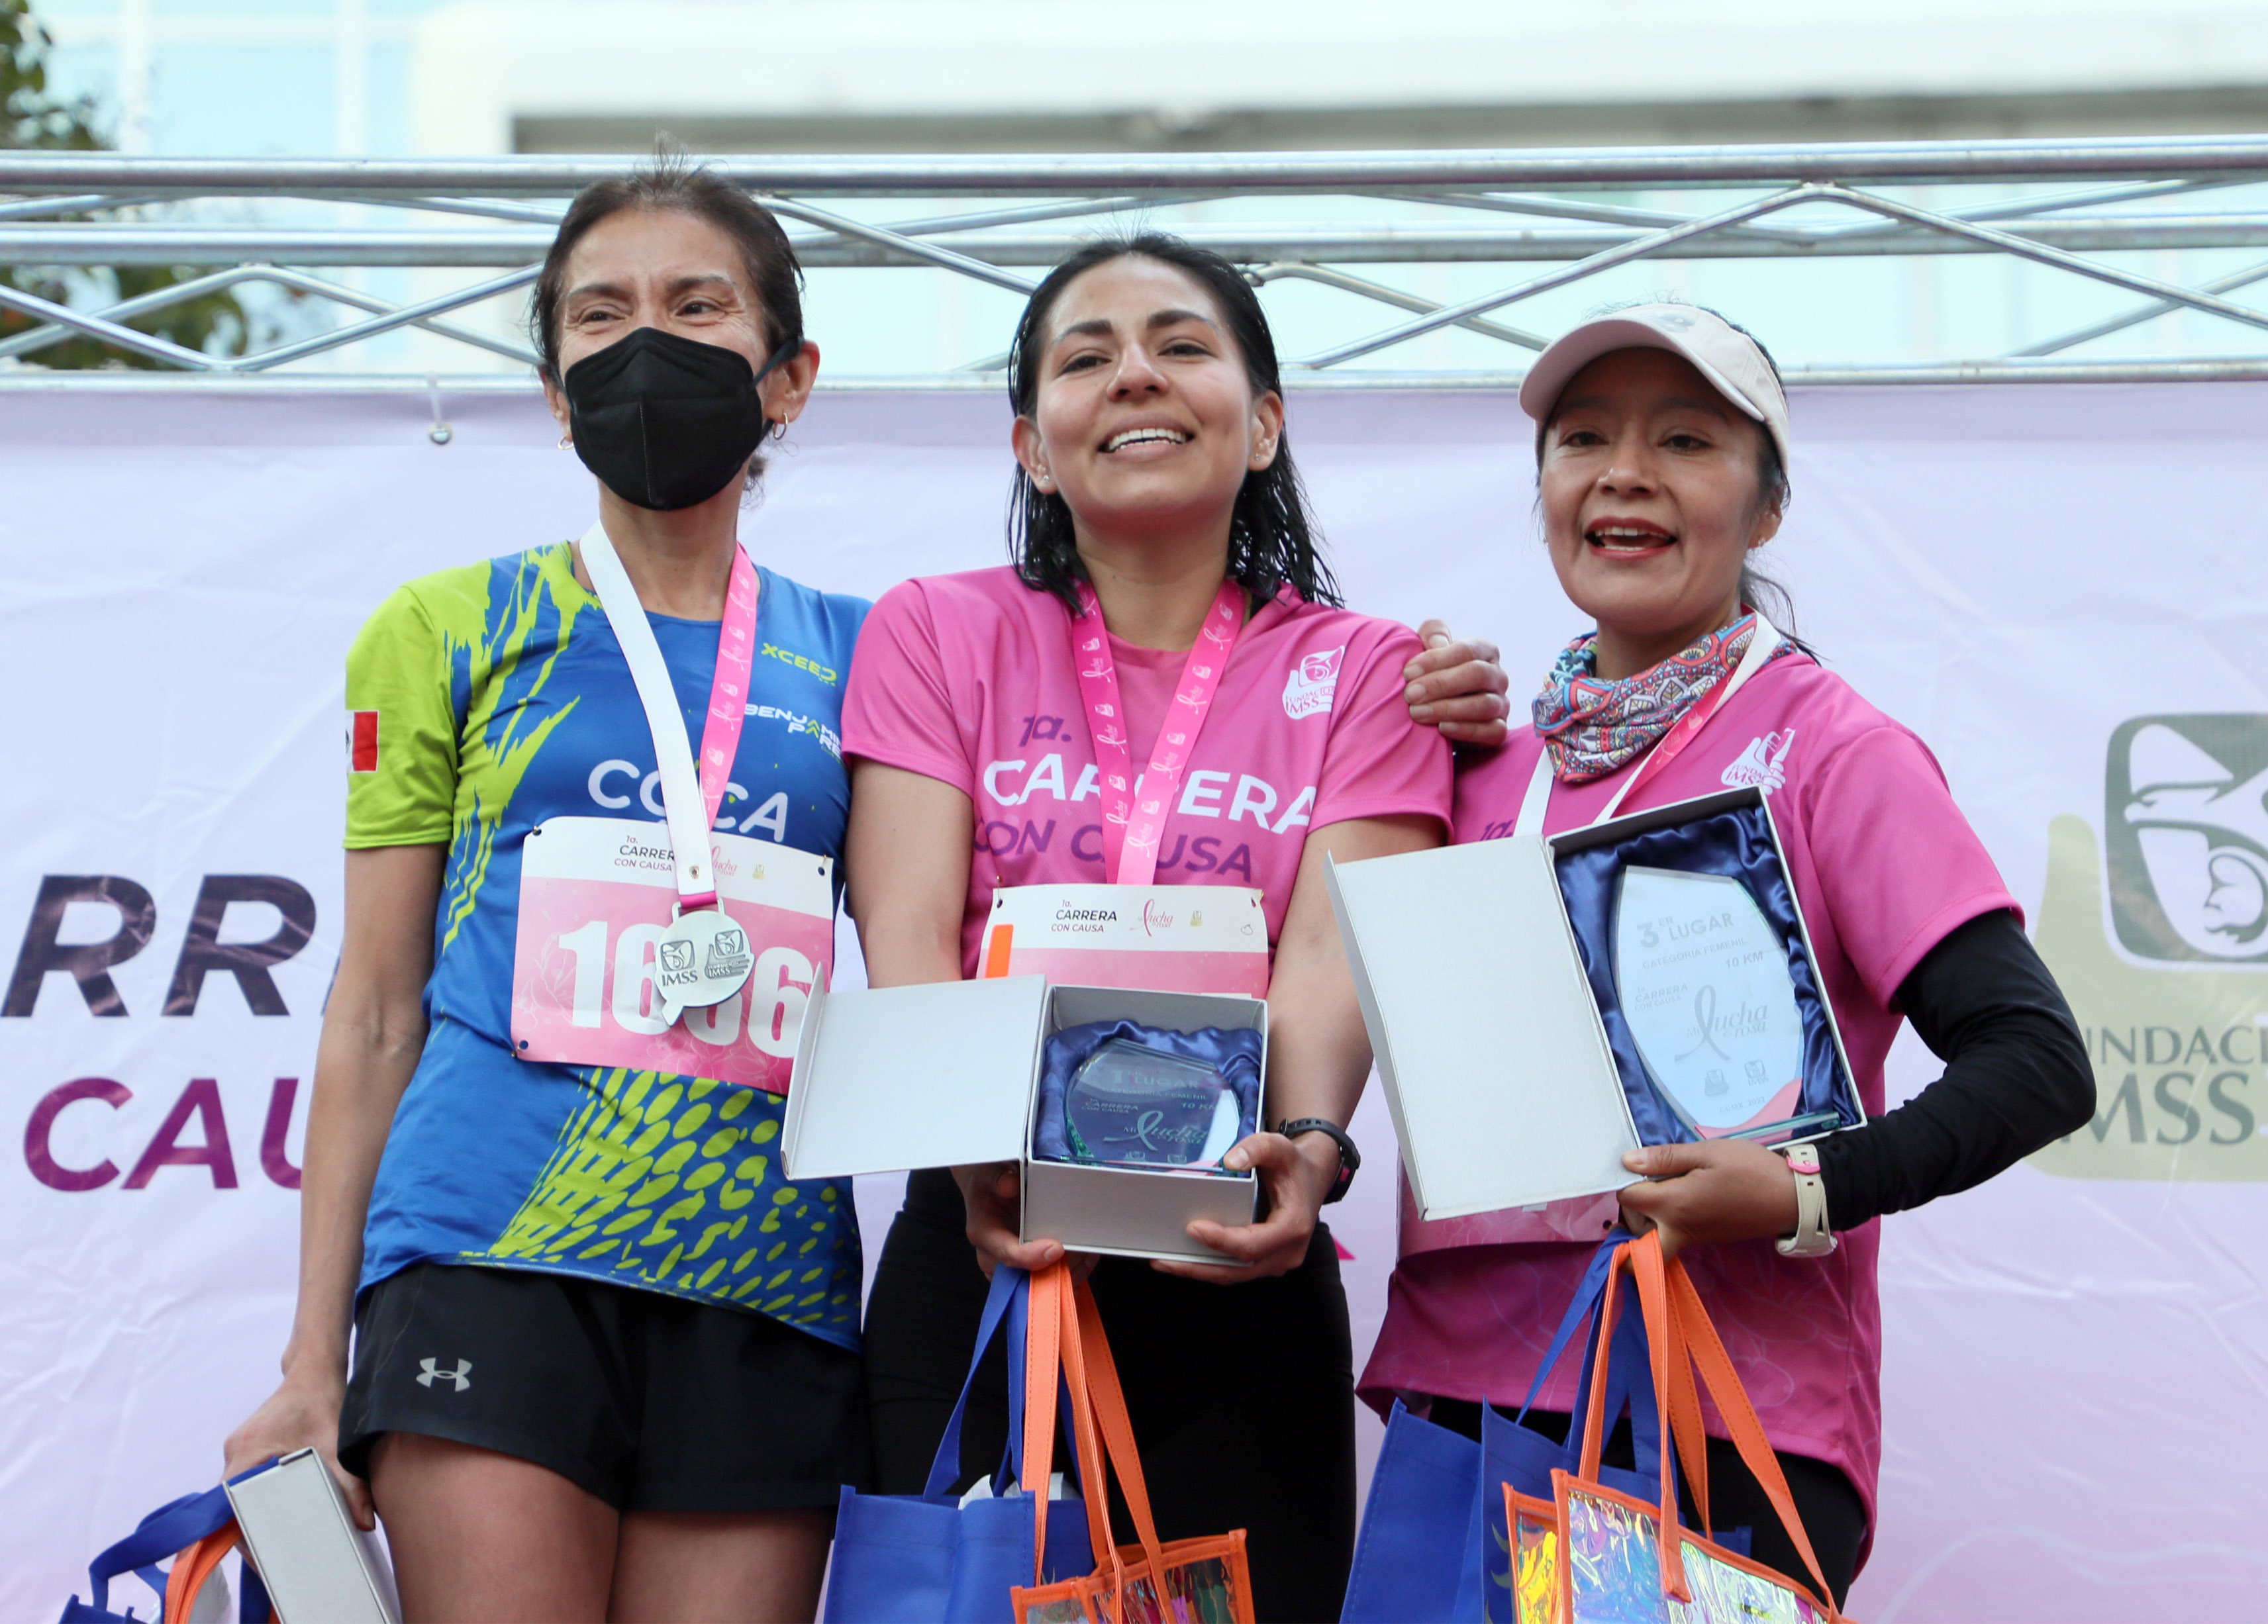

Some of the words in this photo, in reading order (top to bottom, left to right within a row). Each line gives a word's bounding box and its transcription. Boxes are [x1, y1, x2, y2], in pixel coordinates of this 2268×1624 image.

[761, 642, 837, 683] XCEED
[1285, 698, 1319, 714] IMSS
[619, 845, 675, 861] CARRER
[1071, 824, 1252, 883] CUSA
[614, 858, 637, 868] CON
[639, 861, 673, 872] CAUSA
[1061, 898, 1072, 908] 1a.
[1056, 909, 1118, 922] CARRERA
[1051, 924, 1070, 932] CON
[1072, 924, 1105, 933] CAUSA
[1636, 921, 1660, 949] 3
[1669, 912, 1734, 941] LUGAR
[0, 873, 342, 1018] RR
[1642, 948, 1702, 970] CATEGORIA
[1704, 937, 1748, 956] FEMENIL
[1725, 957, 1740, 969] 10
[1744, 949, 1763, 966] KM
[661, 971, 699, 987] IMSS
[1636, 982, 1688, 1003] CARRERA
[1634, 1000, 1652, 1012] CON
